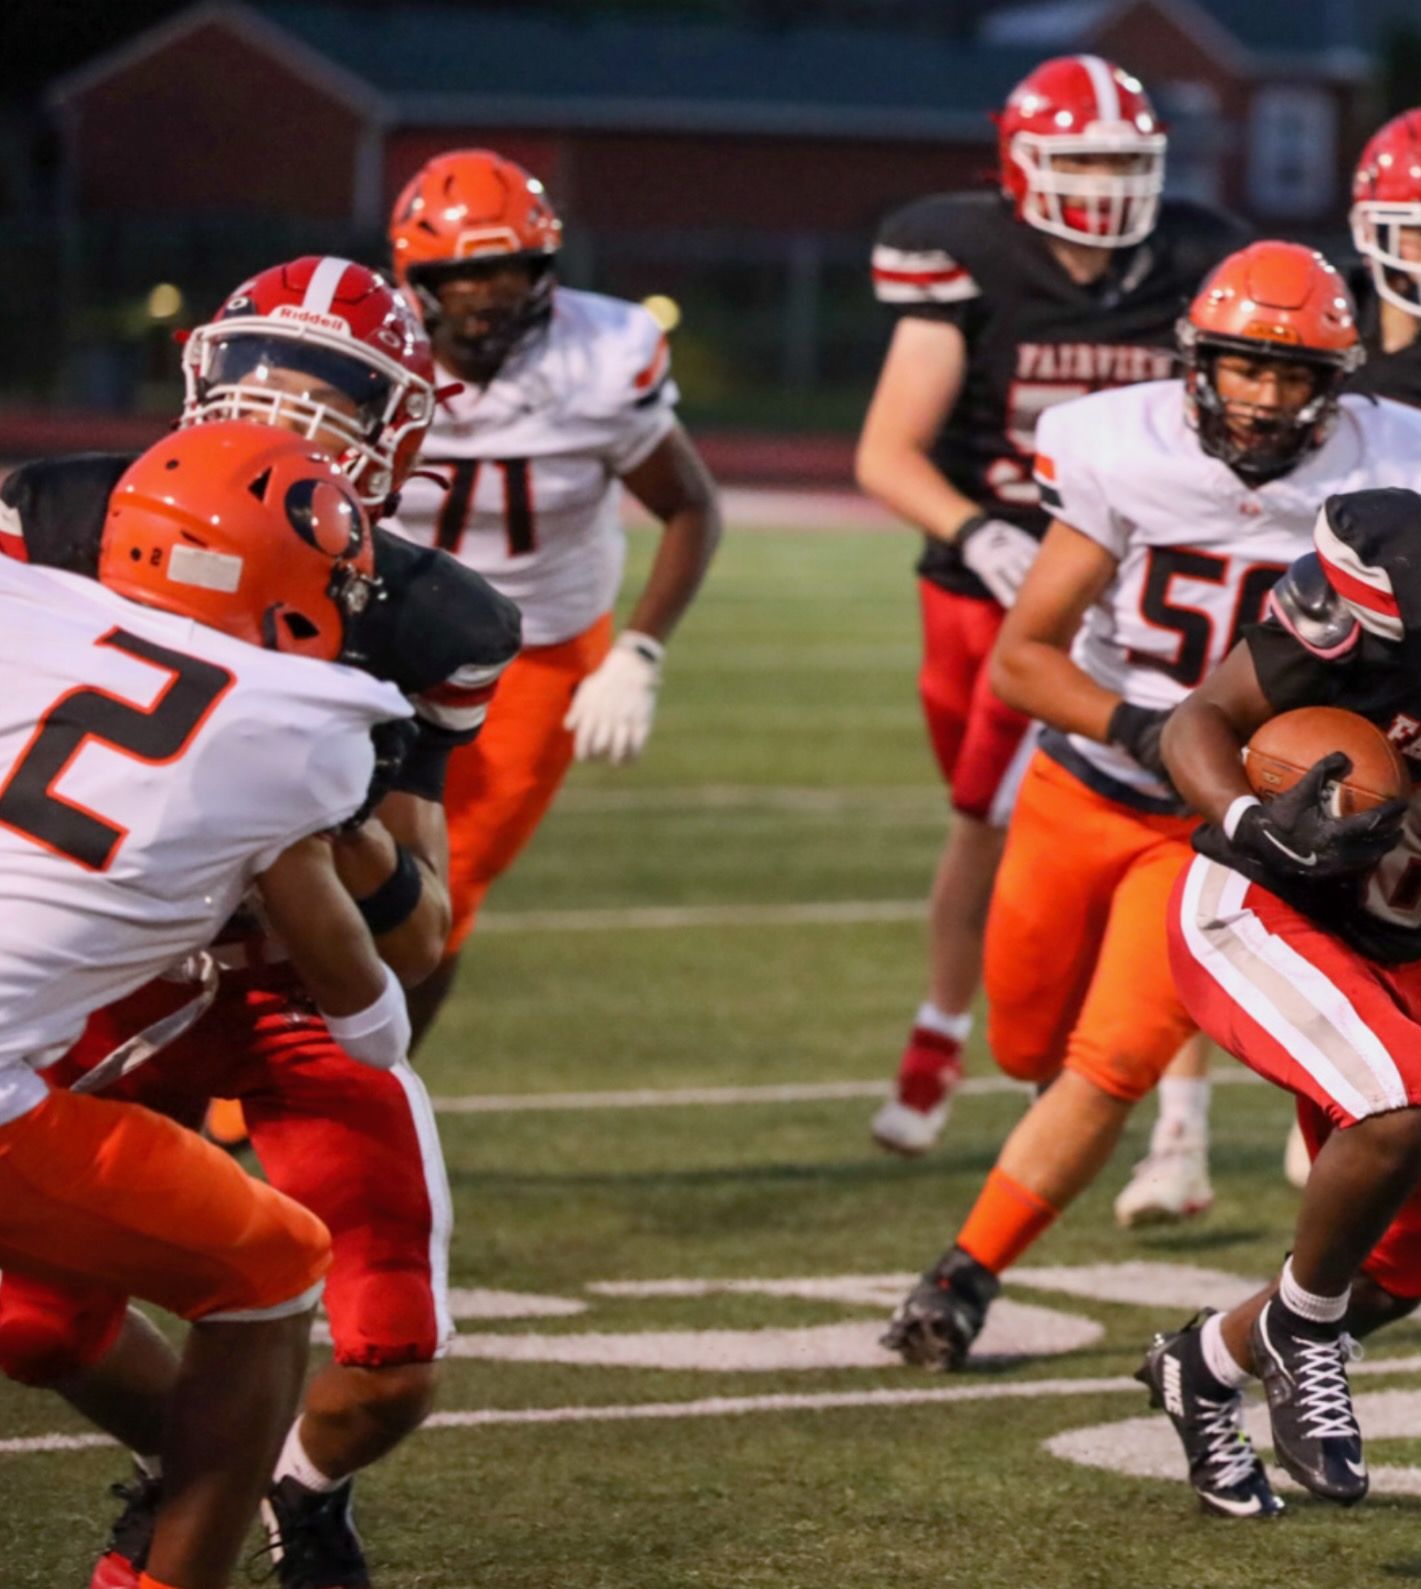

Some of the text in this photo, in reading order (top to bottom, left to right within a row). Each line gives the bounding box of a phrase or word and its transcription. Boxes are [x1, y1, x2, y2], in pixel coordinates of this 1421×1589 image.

[418, 456, 540, 558] 71
[0, 624, 238, 873] 2
[1162, 1352, 1185, 1417] NIKE
